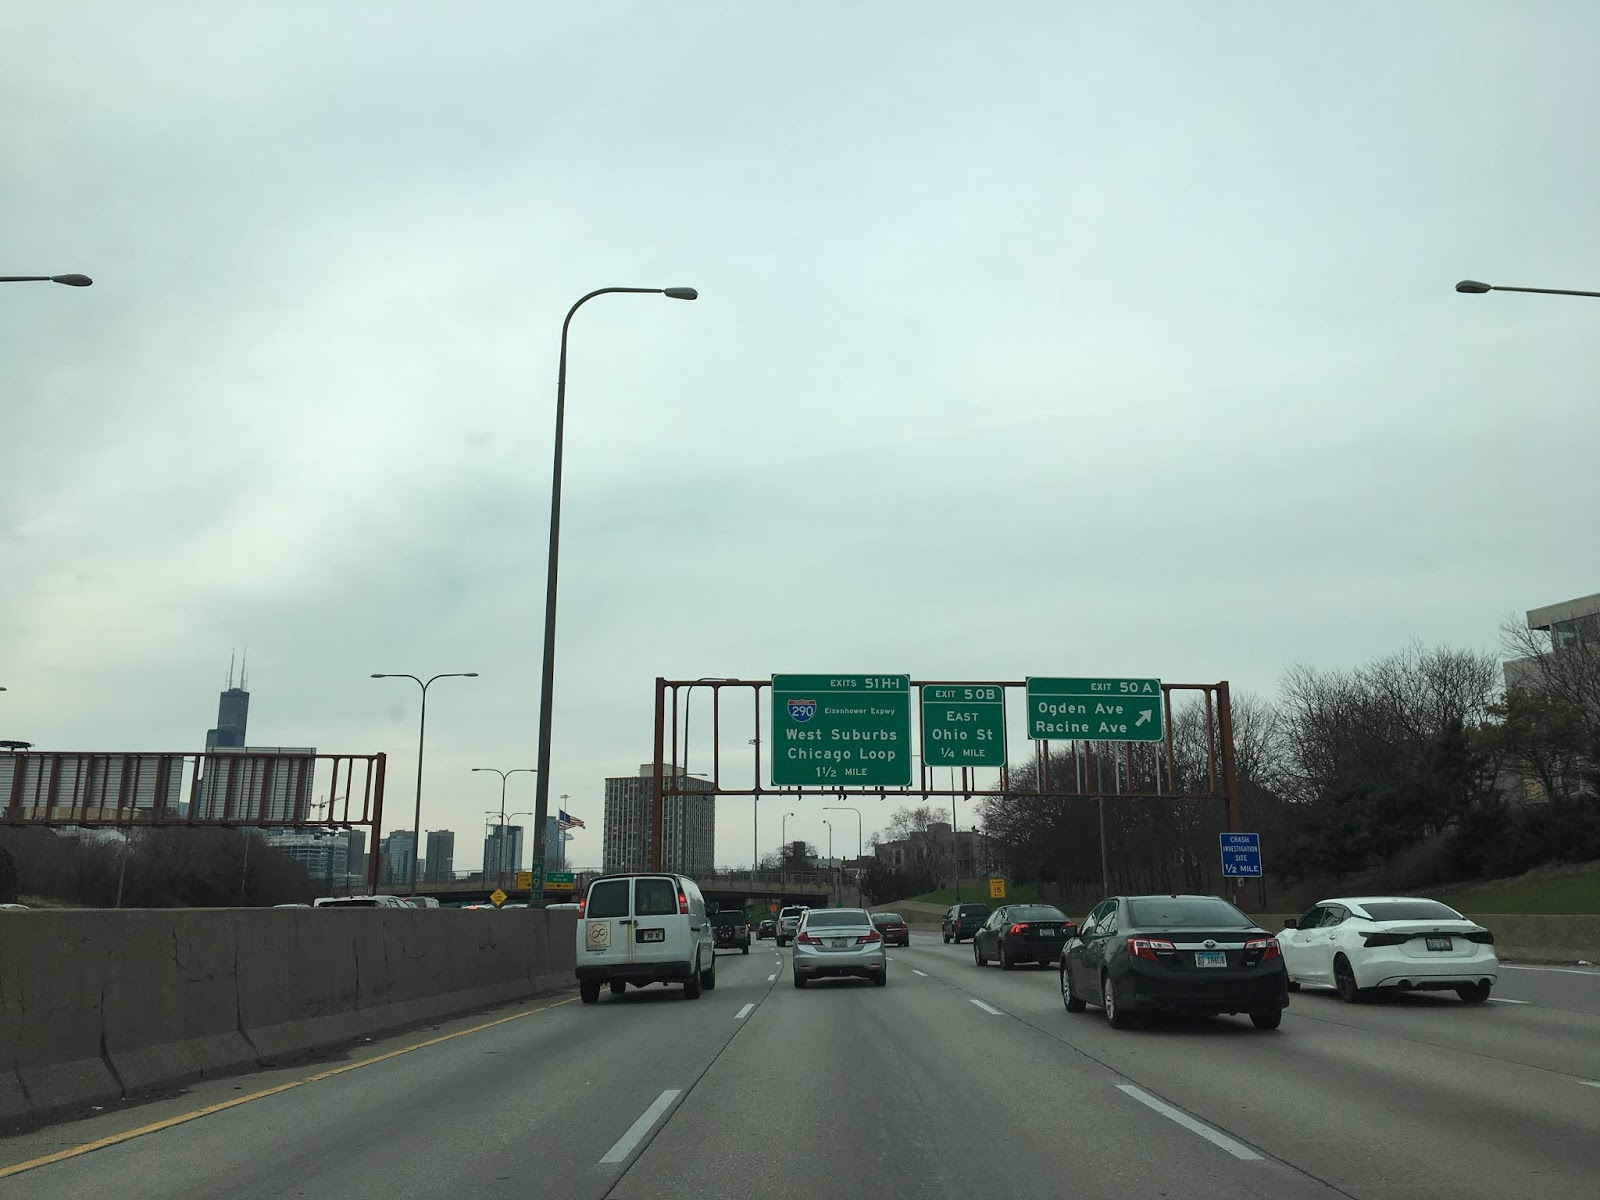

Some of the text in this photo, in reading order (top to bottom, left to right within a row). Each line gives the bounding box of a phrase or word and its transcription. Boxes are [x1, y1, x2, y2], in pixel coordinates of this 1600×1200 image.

[830, 679, 857, 687] EXITS
[1090, 683, 1112, 691] EXIT
[935, 689, 995, 700] EXIT 50B
[791, 706, 814, 717] 290
[824, 707, 896, 716] Eisenhower Expwy
[1038, 702, 1124, 717] Ogden Ave
[946, 710, 979, 721] EAST
[1035, 720, 1128, 733] Racine Ave
[786, 729, 897, 740] West Suburbs
[932, 728, 993, 740] Ohio St
[787, 748, 896, 762] Chicago Loop
[962, 749, 985, 757] MILE
[844, 768, 868, 776] MILE
[1234, 854, 1248, 862] SITE
[1239, 865, 1259, 873] MILE
[993, 886, 1002, 894] 15
